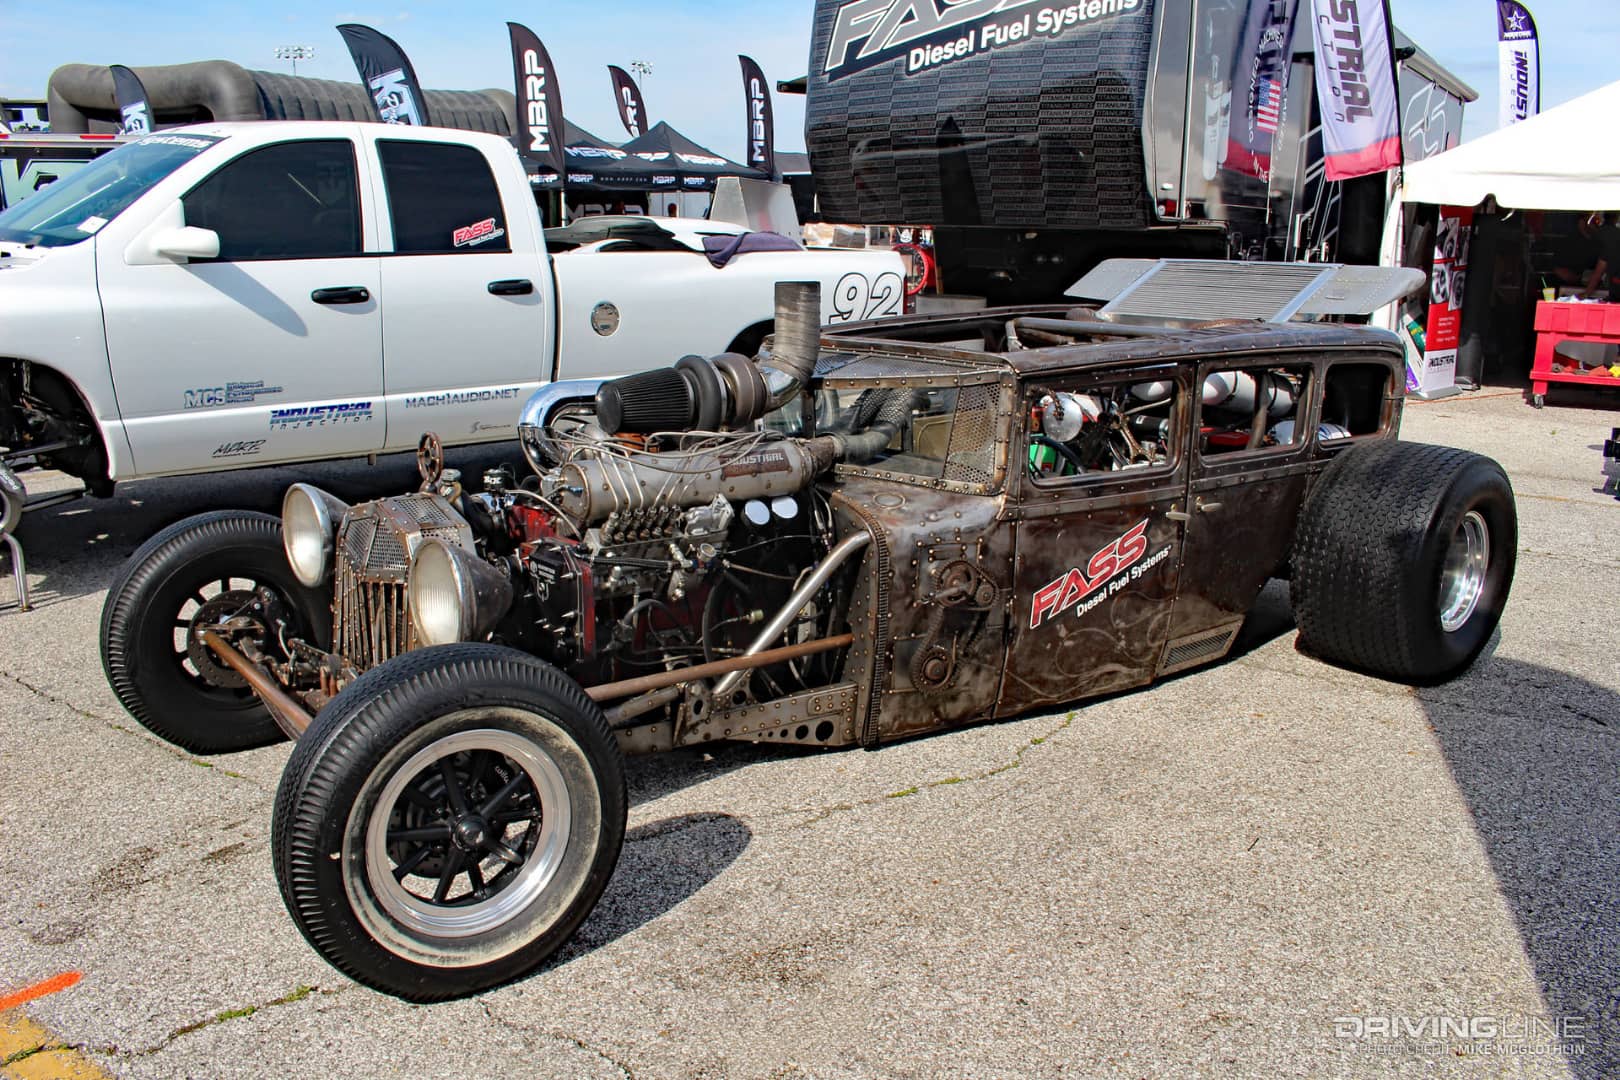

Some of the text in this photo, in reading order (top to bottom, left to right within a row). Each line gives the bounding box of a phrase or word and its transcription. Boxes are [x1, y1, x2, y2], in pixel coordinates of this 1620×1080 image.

[825, 0, 1040, 72] FA
[908, 30, 975, 72] Diesel
[981, 15, 1029, 49] Fuel
[524, 49, 550, 151] MBRP
[751, 77, 766, 162] MBRP
[568, 173, 594, 183] MBRP
[652, 175, 676, 184] MBRP
[684, 176, 706, 185] MBRP
[455, 218, 494, 245] FASS
[829, 272, 903, 324] 92
[405, 388, 521, 408] MACH1AUDIO.NET
[1030, 517, 1149, 629] FASS
[1077, 588, 1107, 617] Diesel
[1109, 572, 1129, 595] Fuel
